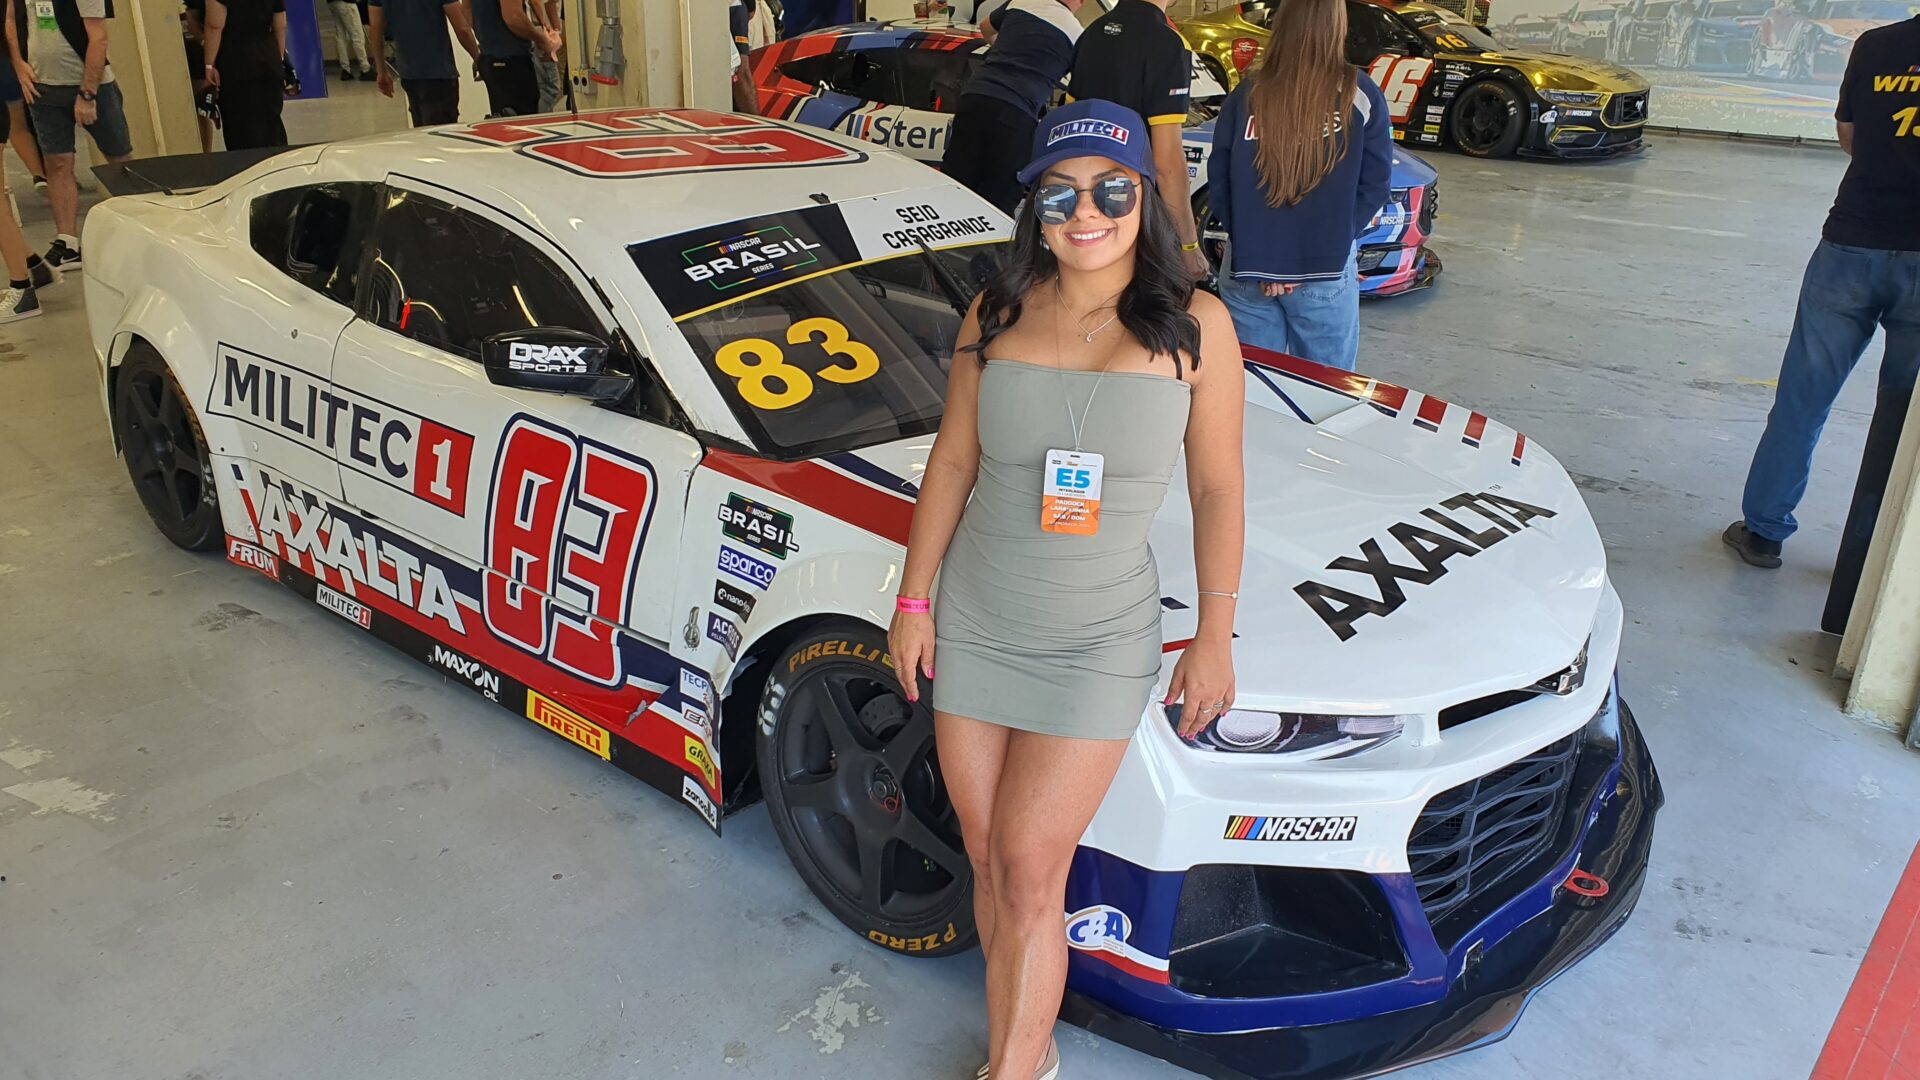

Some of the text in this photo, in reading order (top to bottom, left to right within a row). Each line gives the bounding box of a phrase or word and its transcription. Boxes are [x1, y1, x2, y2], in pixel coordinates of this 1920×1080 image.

[1436, 34, 1468, 49] 16
[1368, 54, 1434, 122] 16
[896, 204, 940, 223] SEID
[1380, 216, 1405, 225] NASCAR
[729, 236, 762, 252] NASCAR
[882, 215, 995, 249] CASAGRANDE
[683, 237, 821, 282] BRASIL
[752, 262, 775, 274] SERIES
[509, 342, 587, 365] DRAX
[509, 361, 587, 373] SPORTS
[715, 317, 880, 410] 83
[1056, 467, 1091, 489] E5
[719, 505, 799, 550] BRASIL
[752, 508, 773, 521] NASCAR
[230, 540, 277, 578] FRUM
[258, 483, 467, 635] AXALTA
[476, 411, 658, 690] 83
[720, 549, 774, 583] sparco
[1292, 492, 1558, 642] AXALTA
[434, 645, 500, 694] MAXON
[788, 640, 880, 673] PIRELLI
[483, 689, 499, 702] OIL
[534, 695, 602, 752] PIRELLI
[1255, 816, 1357, 840] NASCAR
[1069, 911, 1124, 943] CBA
